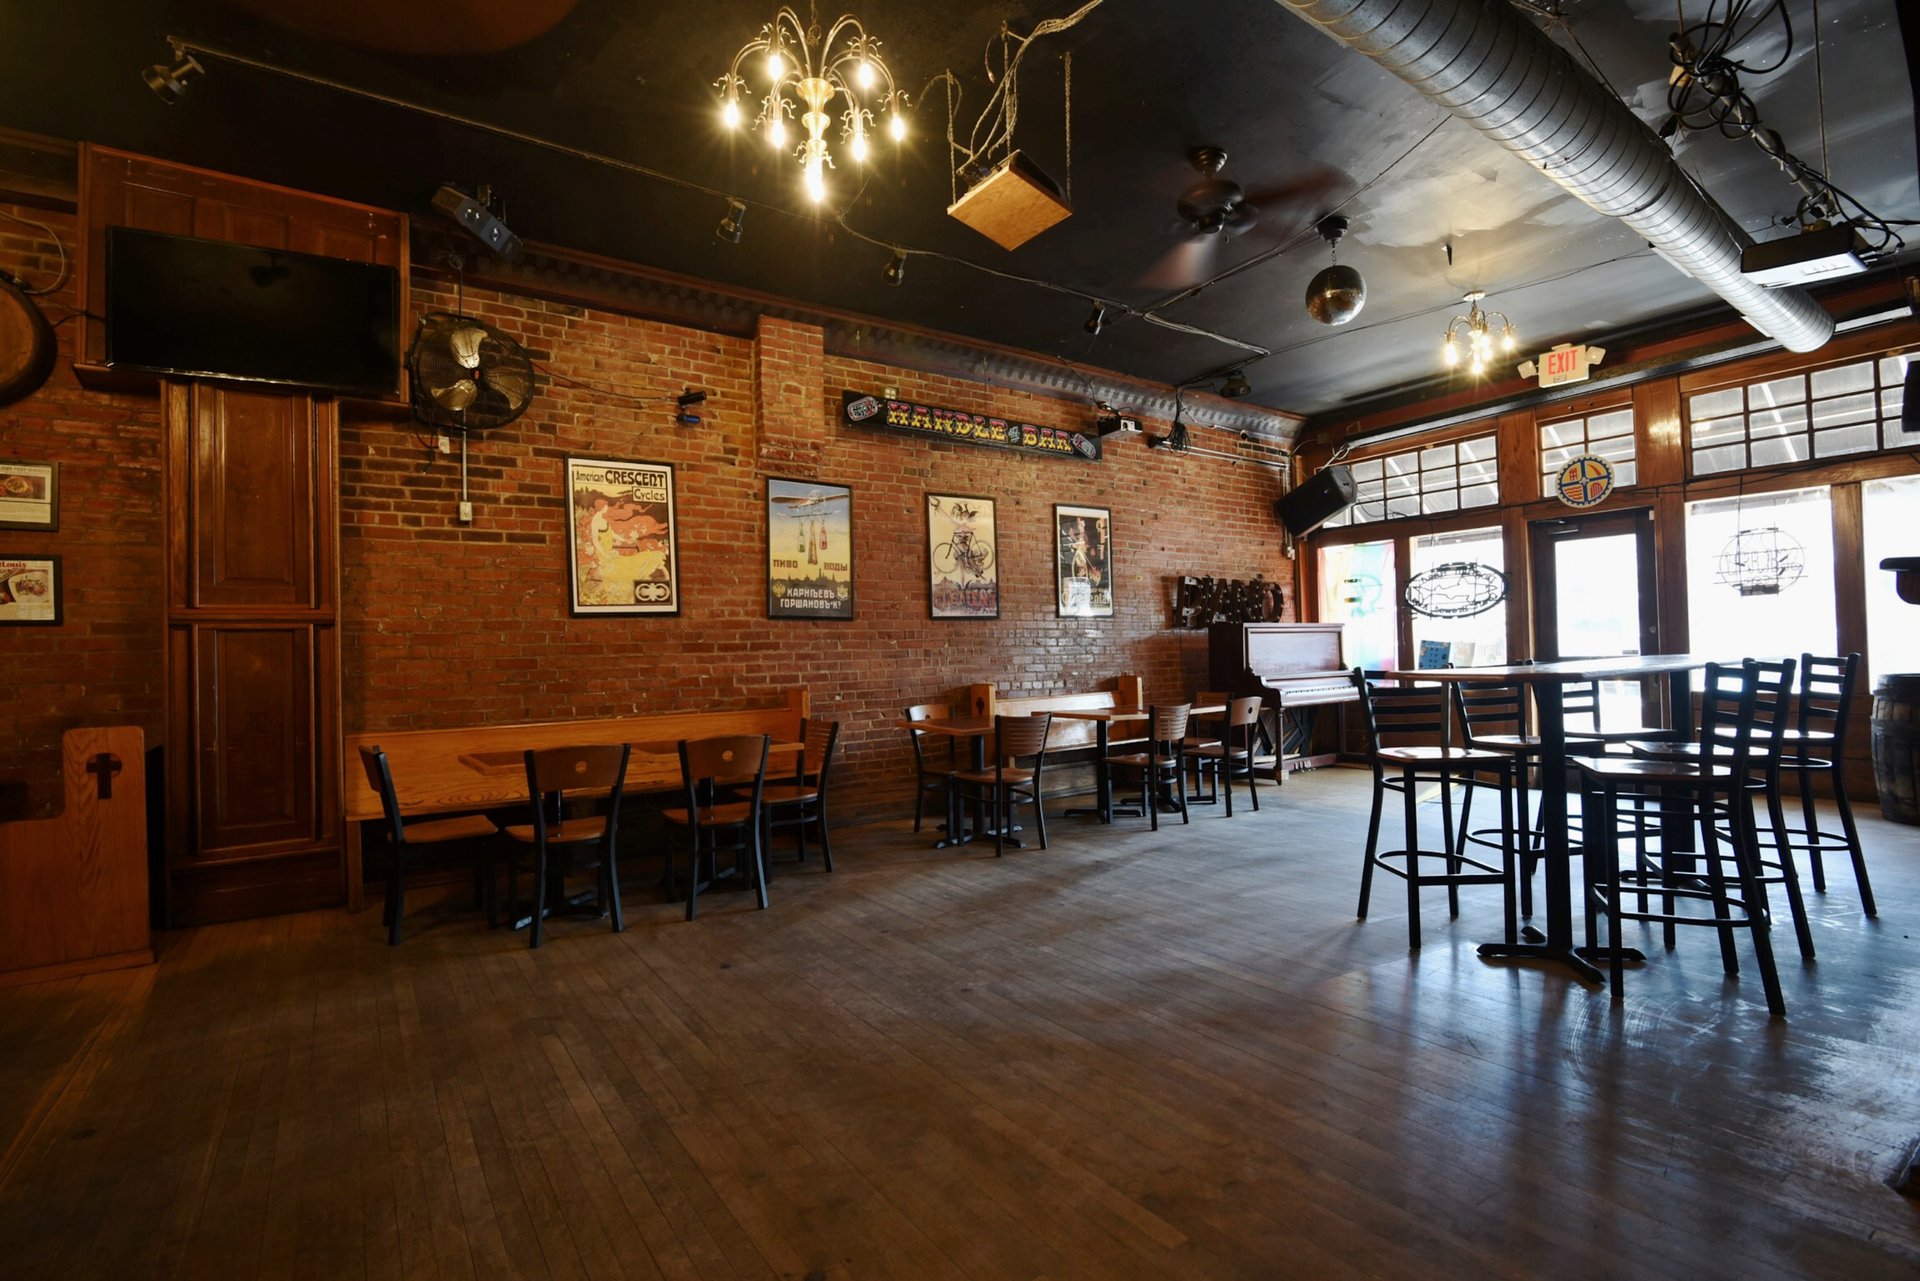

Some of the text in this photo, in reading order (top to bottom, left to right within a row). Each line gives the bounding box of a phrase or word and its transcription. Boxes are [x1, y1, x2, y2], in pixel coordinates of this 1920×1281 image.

[1548, 350, 1577, 374] EXIT
[887, 401, 1008, 443] HANDLE
[1022, 424, 1074, 453] BAR
[576, 470, 665, 487] American CRESCENT
[633, 488, 665, 501] Cycles
[773, 559, 798, 568] ПИВО
[823, 562, 848, 572] ВОДЫ
[1174, 576, 1284, 630] PIANO
